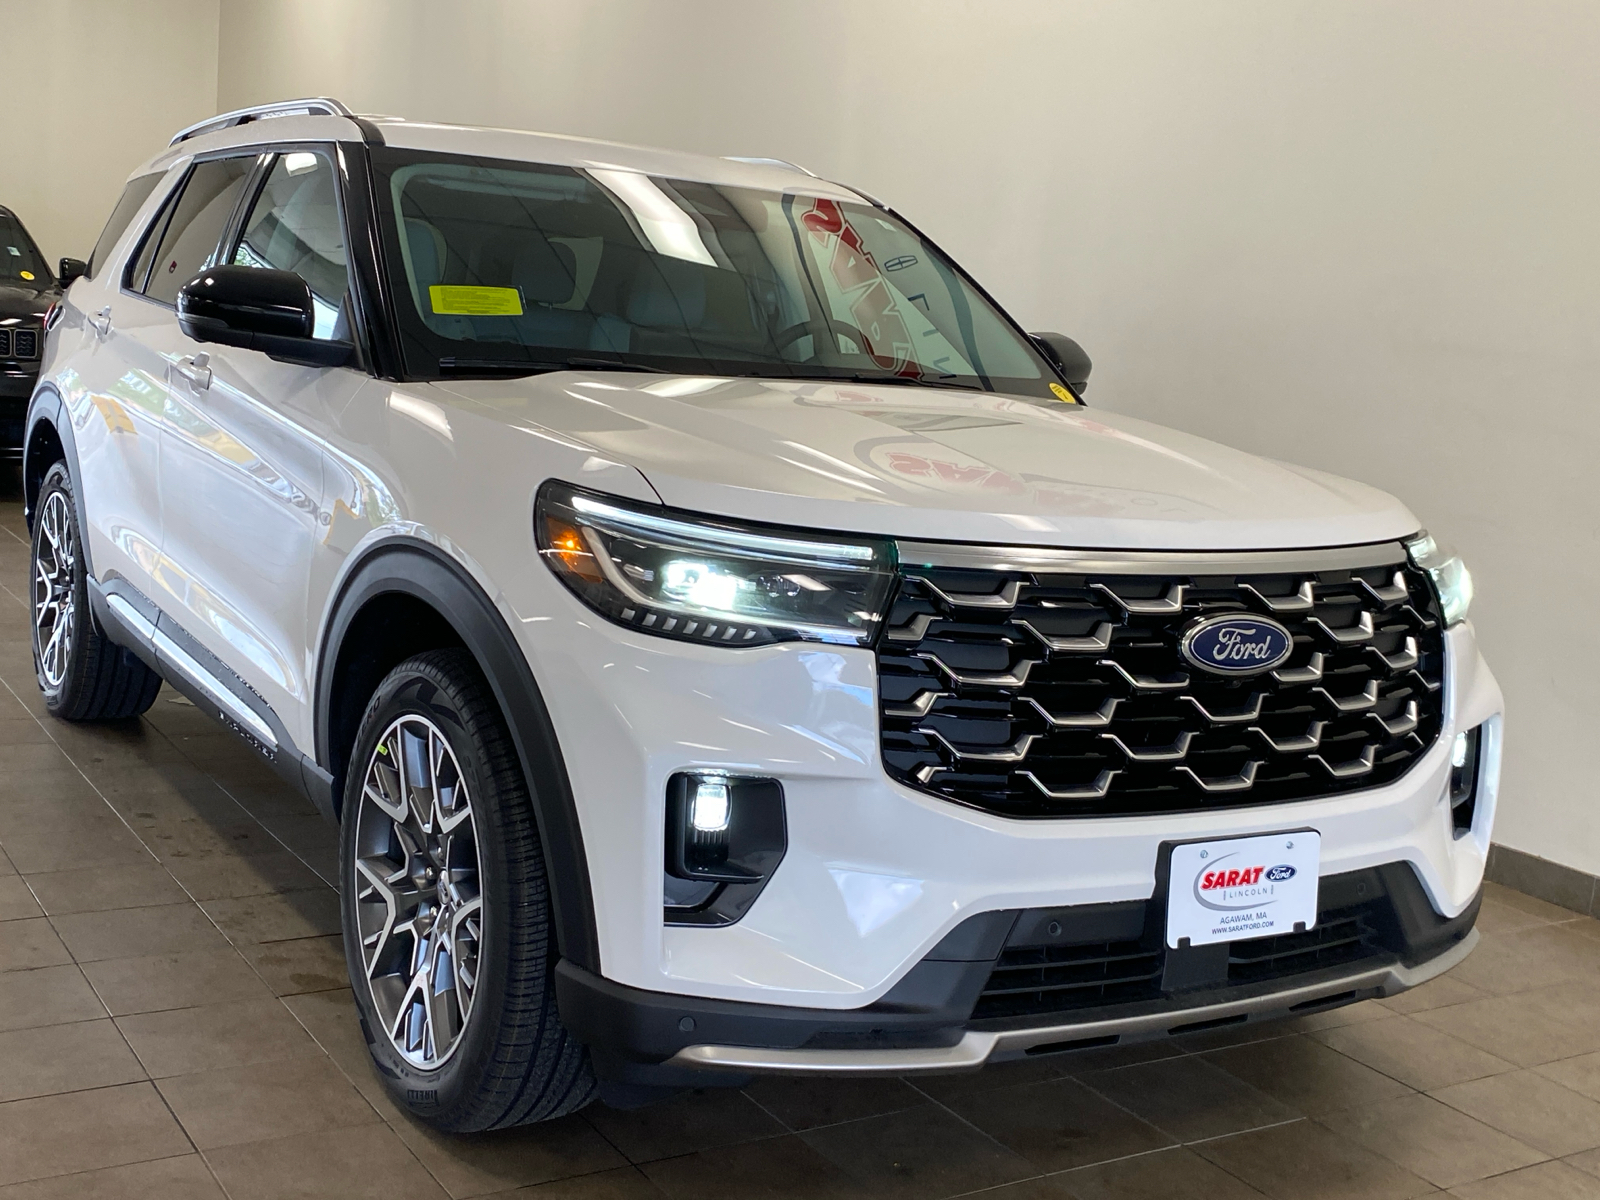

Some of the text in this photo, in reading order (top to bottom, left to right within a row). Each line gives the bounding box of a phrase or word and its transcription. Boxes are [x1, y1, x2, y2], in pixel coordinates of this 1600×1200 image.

[1212, 627, 1272, 661] Ford
[1200, 865, 1292, 891] SARAT Ford
[1229, 888, 1268, 899] LINCOLN
[1220, 911, 1268, 925] AGAWAM, MA
[1211, 920, 1275, 935] WWW.SARATFORD.COM
